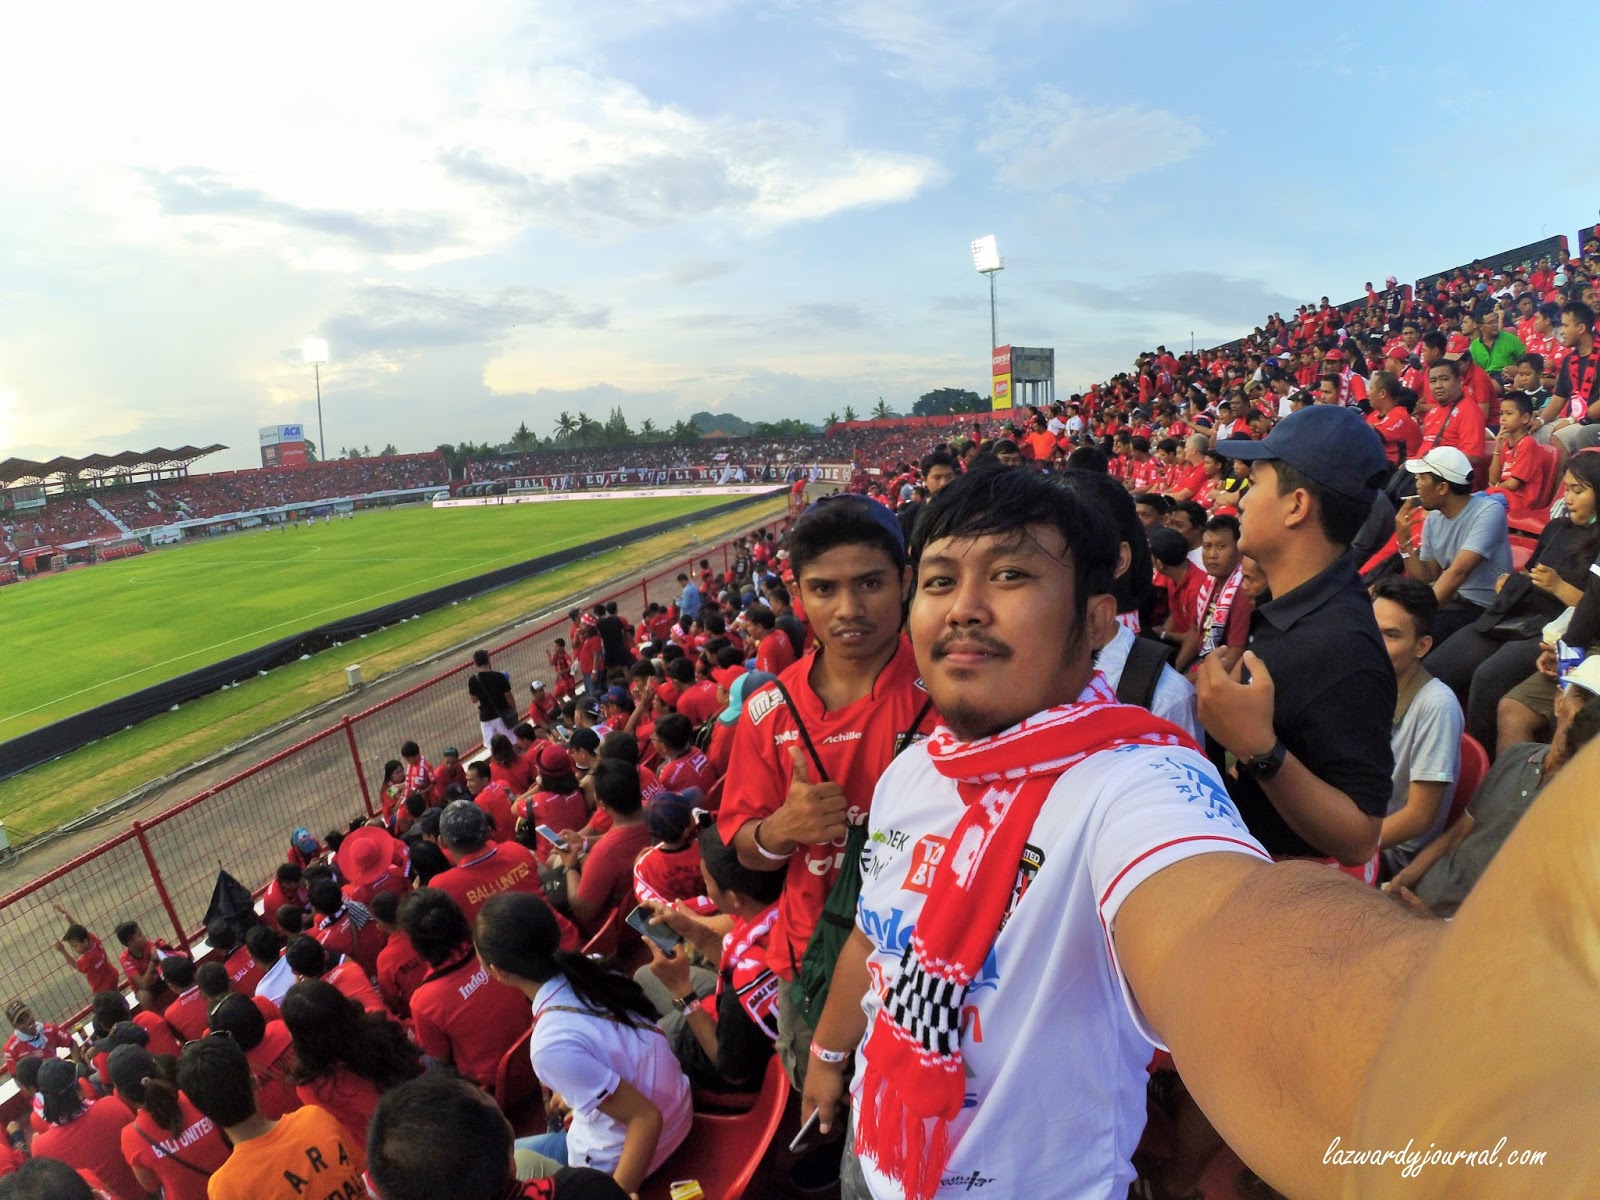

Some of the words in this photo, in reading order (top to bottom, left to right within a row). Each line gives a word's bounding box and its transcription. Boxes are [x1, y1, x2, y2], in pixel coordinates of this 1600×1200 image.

[284, 426, 301, 436] ACA
[610, 473, 628, 483] FC
[466, 882, 497, 905] BALI
[179, 1116, 213, 1147] UNITED
